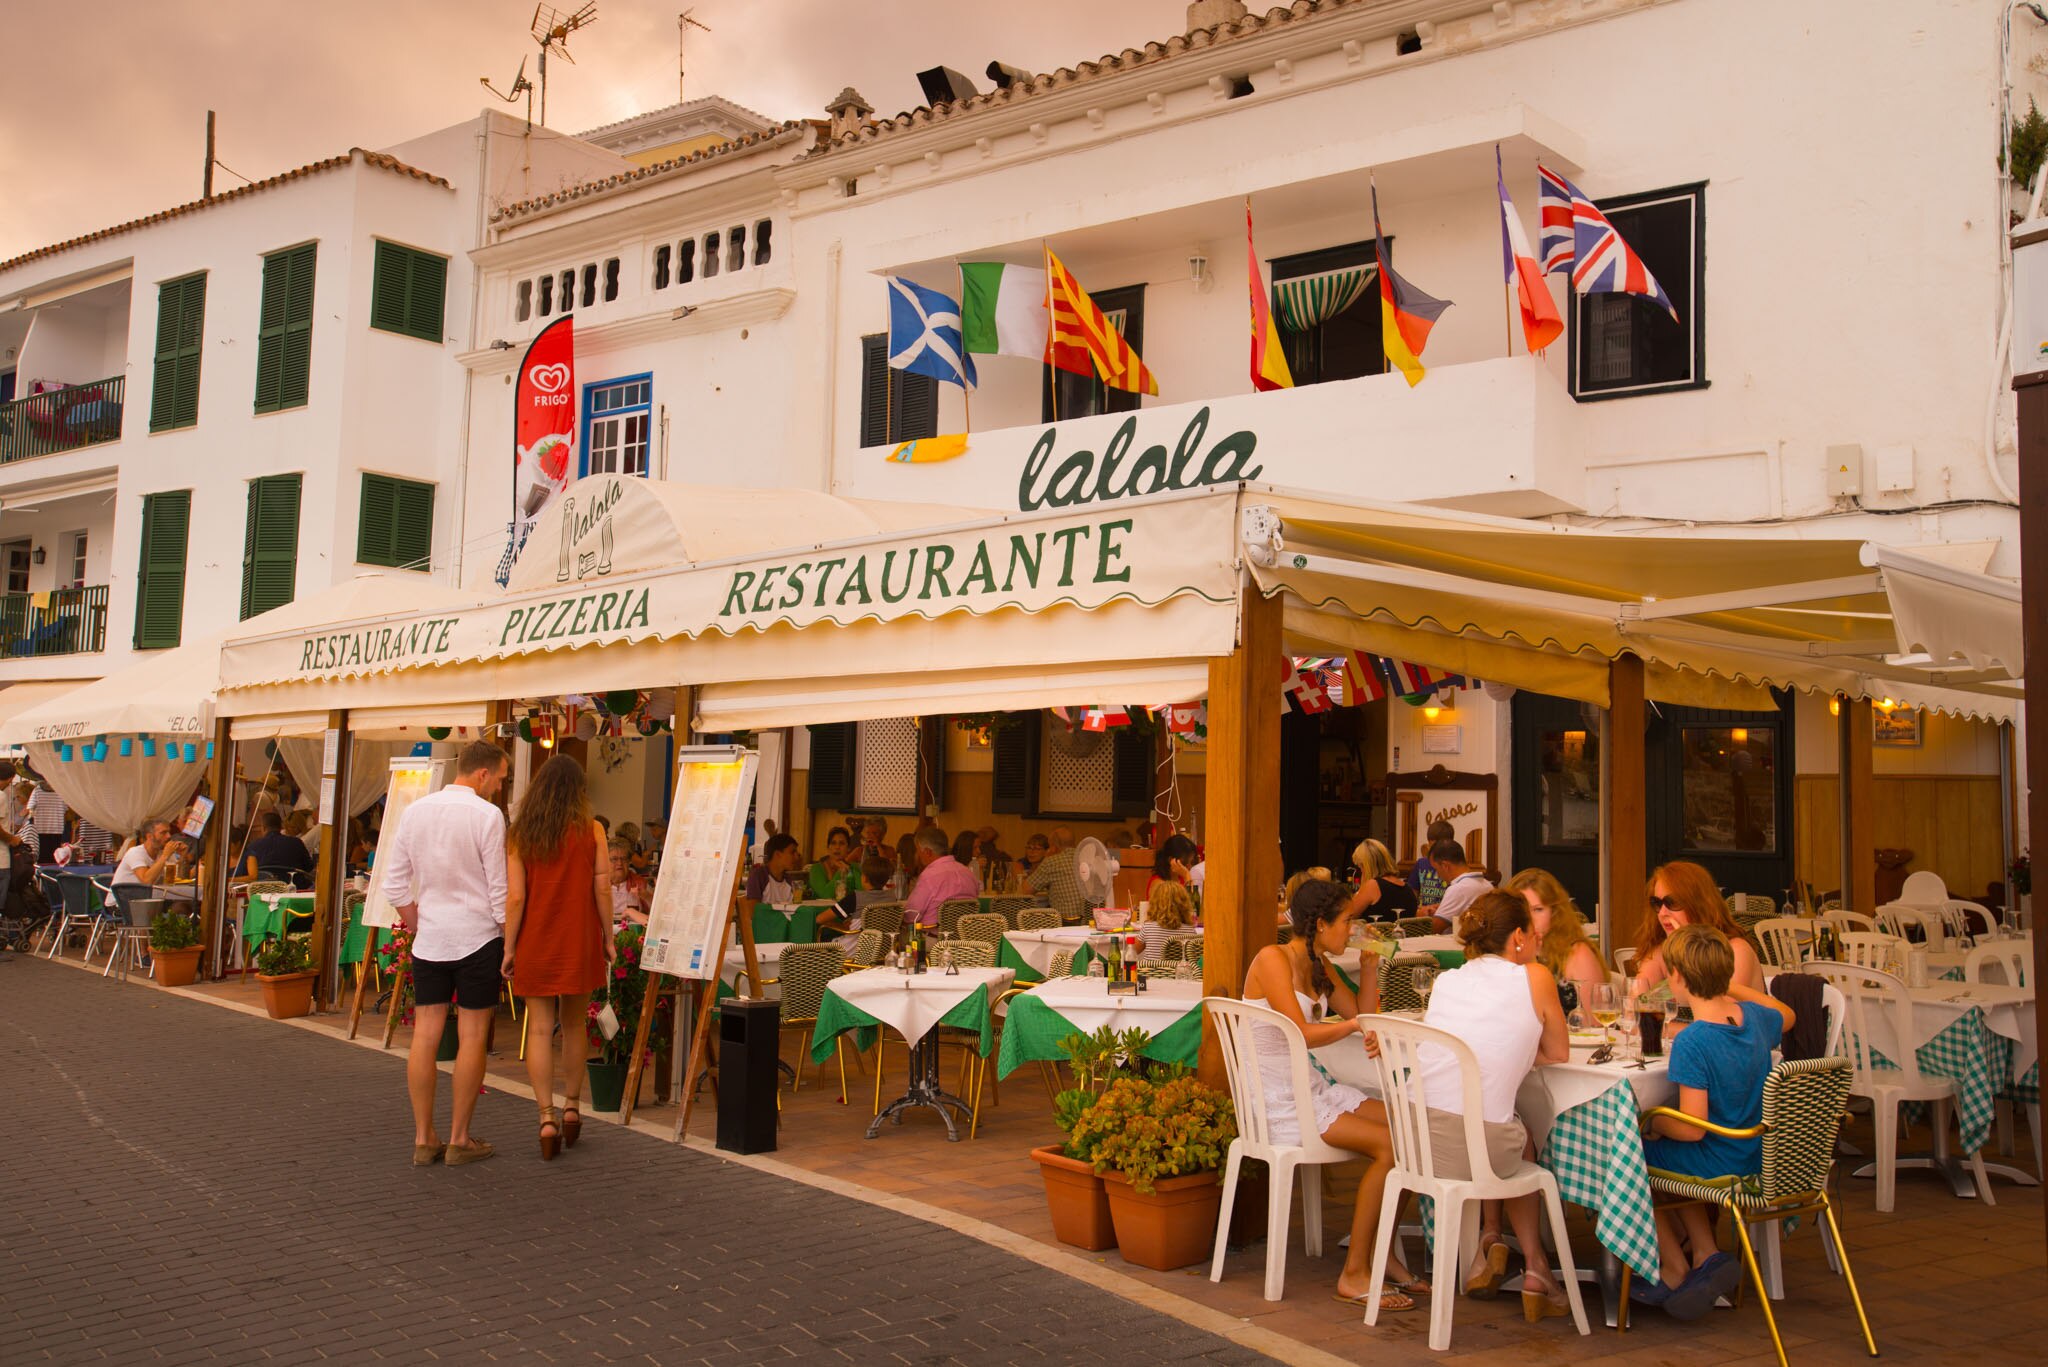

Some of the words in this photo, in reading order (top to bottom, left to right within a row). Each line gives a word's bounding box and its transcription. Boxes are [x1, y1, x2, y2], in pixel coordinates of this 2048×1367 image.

[534, 394, 569, 407] FRIGO
[1019, 405, 1264, 512] lalola
[572, 479, 624, 547] lalola
[718, 518, 1134, 617] RESTAURANTE
[299, 618, 460, 671] RESTAURANTE
[499, 587, 650, 647] PIZZERIA
